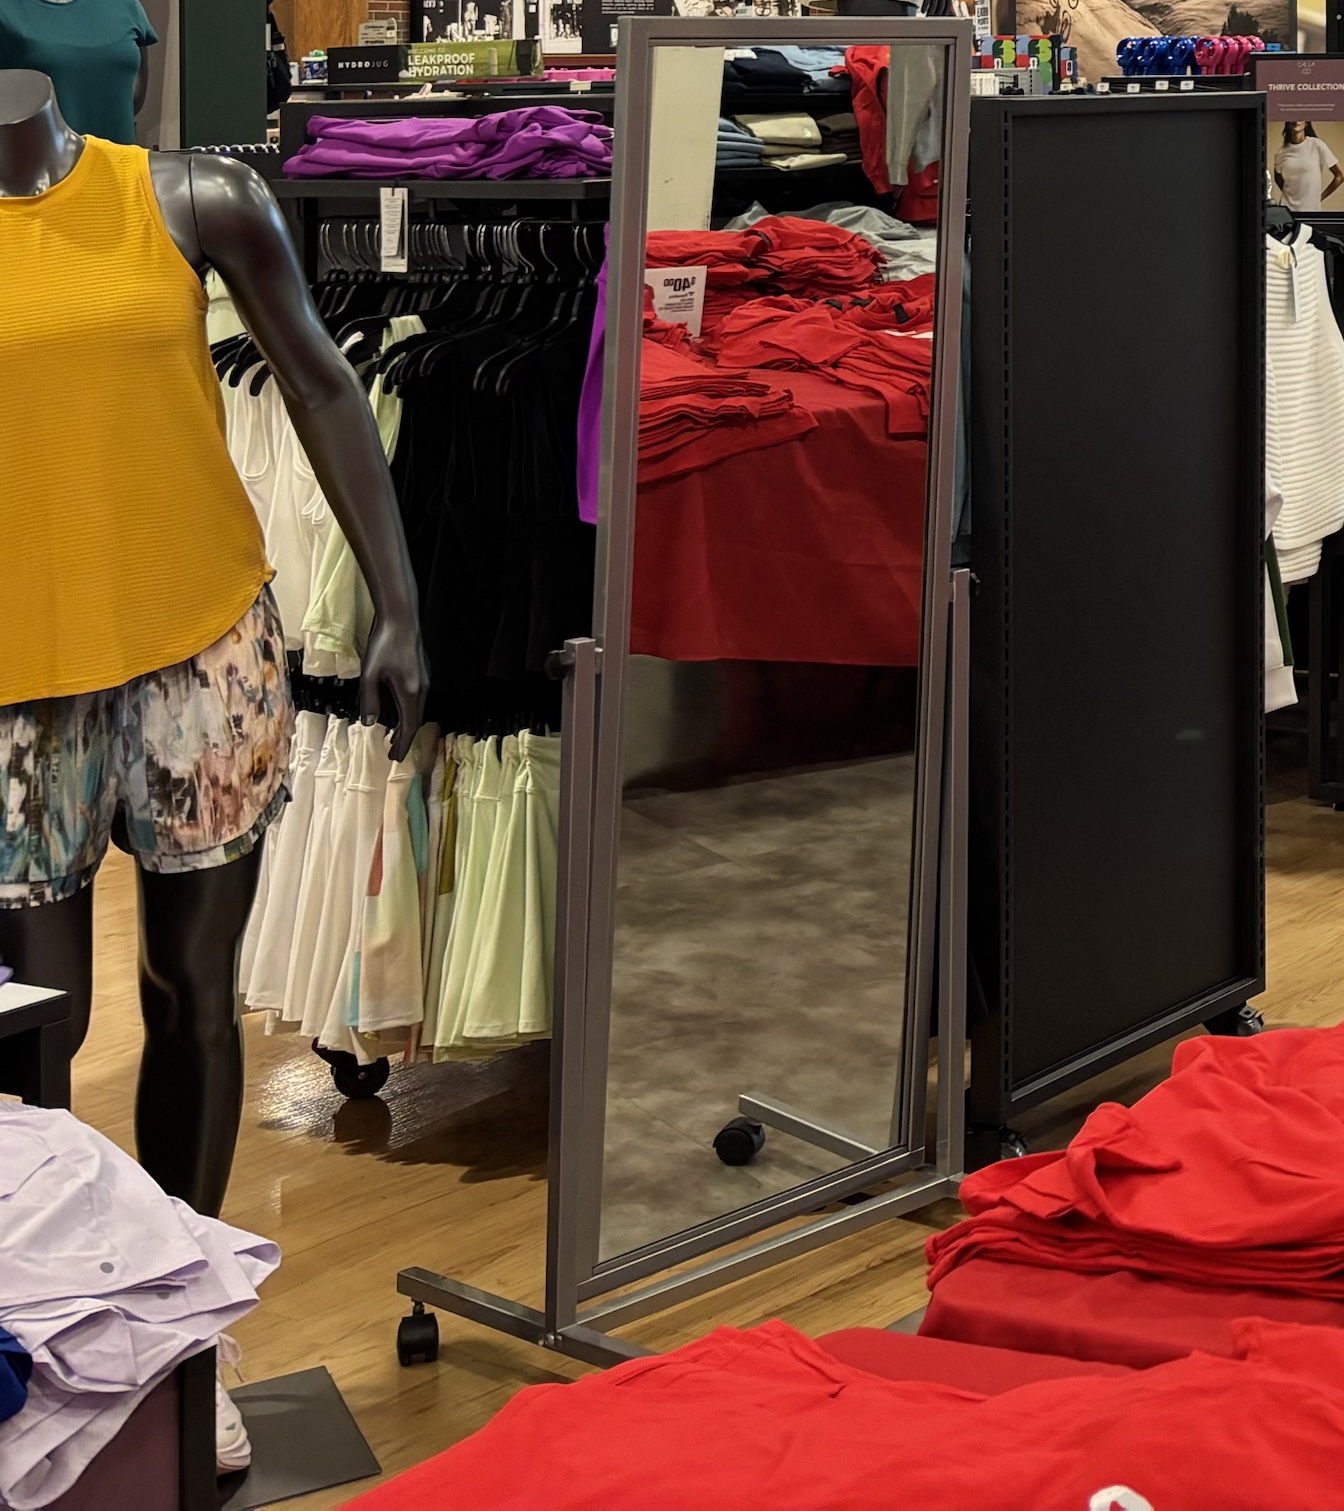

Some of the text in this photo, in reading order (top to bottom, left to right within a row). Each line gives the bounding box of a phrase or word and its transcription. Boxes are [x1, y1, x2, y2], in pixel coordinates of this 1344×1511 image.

[337, 58, 389, 70] HYDROJUG
[407, 52, 475, 66] LEAKPROOF
[407, 64, 475, 78] HYDRATION
[1267, 83, 1295, 91] THRIVE
